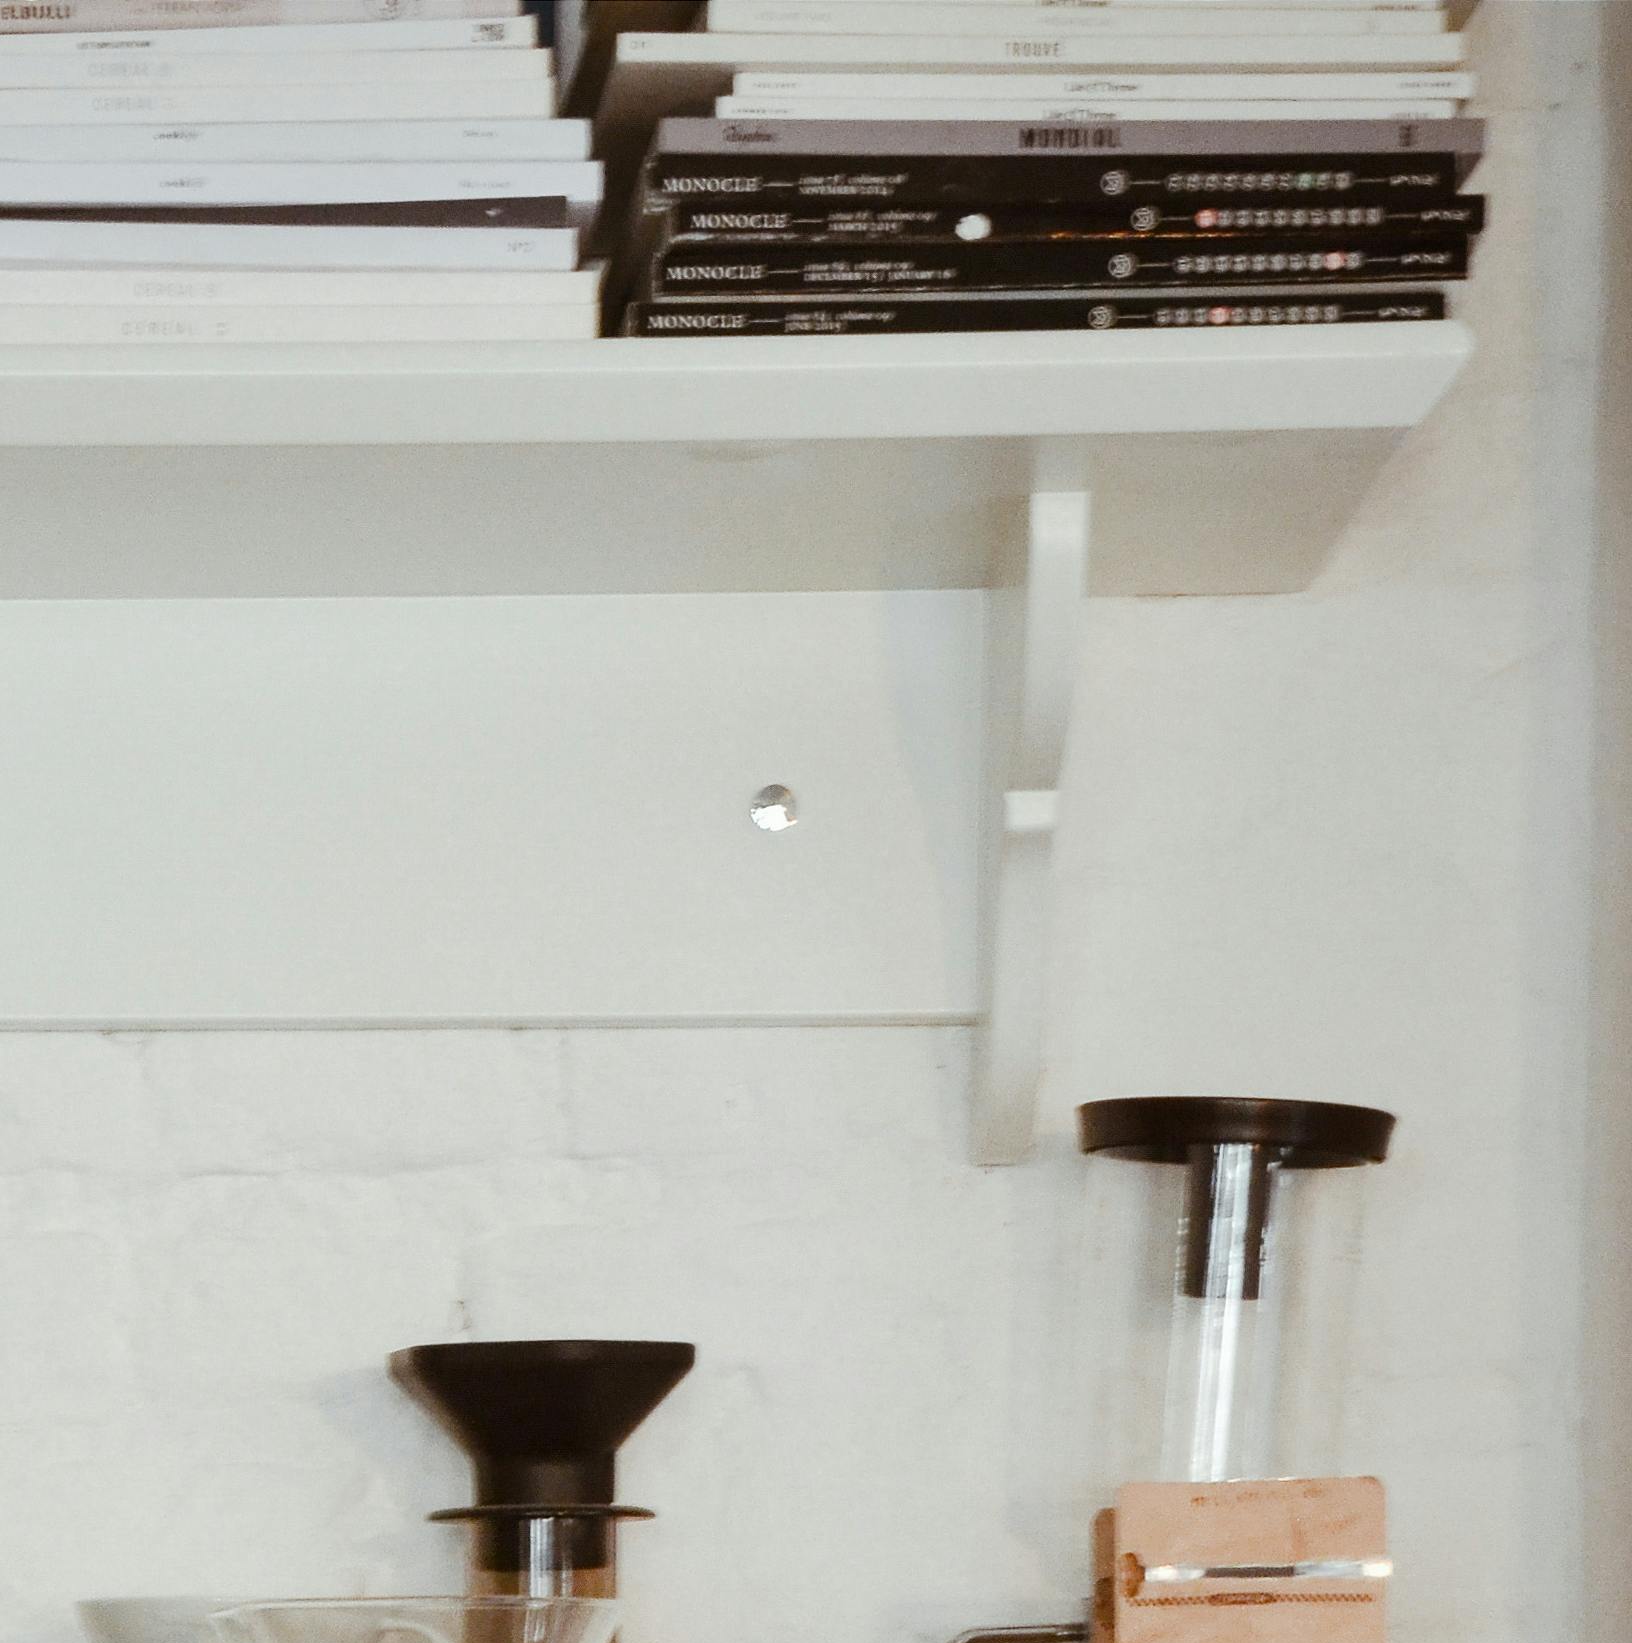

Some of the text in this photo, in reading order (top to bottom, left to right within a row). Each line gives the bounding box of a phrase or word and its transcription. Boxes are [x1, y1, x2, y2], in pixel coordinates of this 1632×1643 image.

[0, 5, 72, 20] ELBULLI
[1006, 42, 1060, 58] TROUVE
[662, 177, 763, 194] MONOCLE
[691, 214, 791, 230] MONOCLE
[667, 264, 766, 281] MONOCLE
[648, 314, 747, 331] MONOCLE
